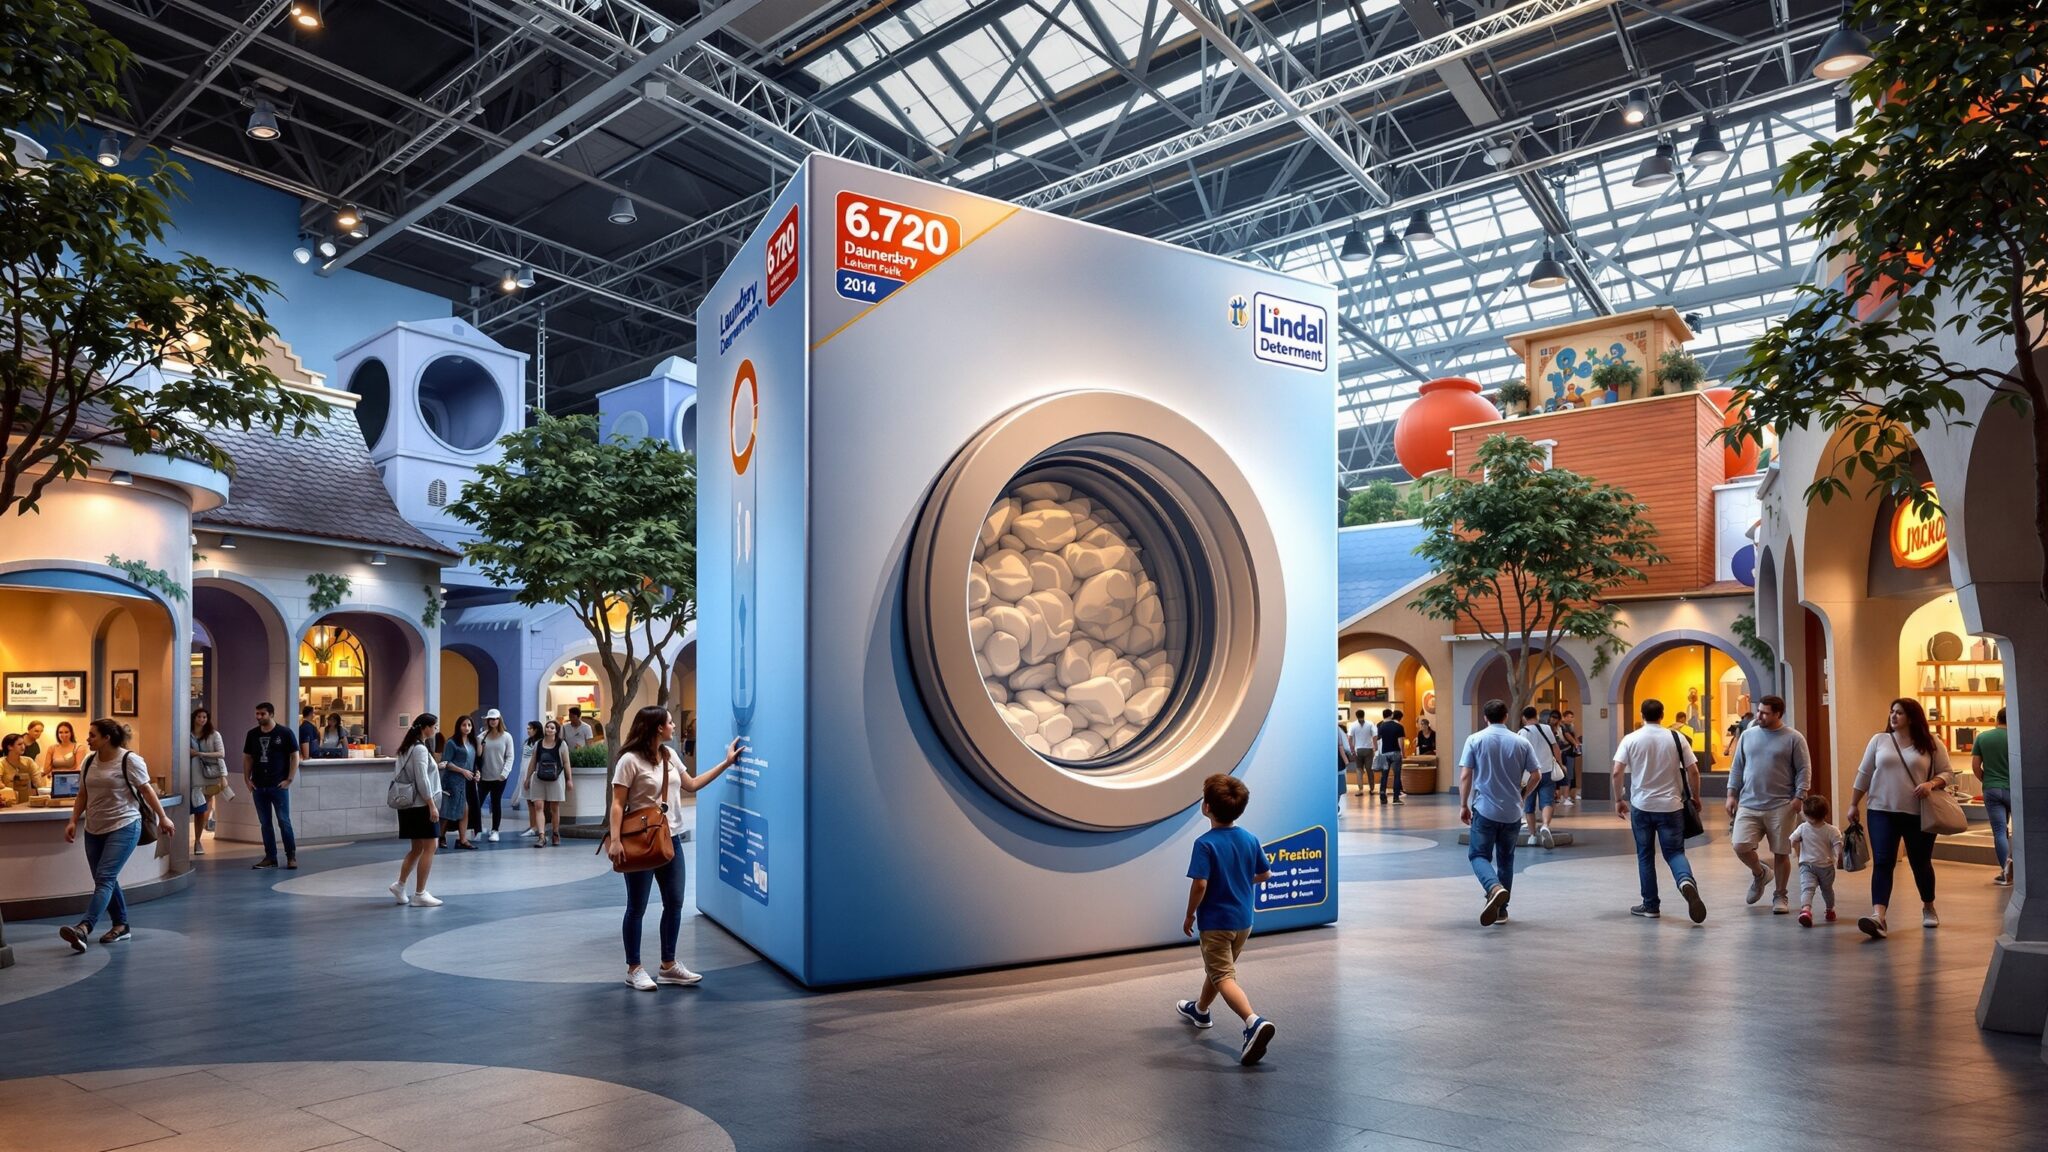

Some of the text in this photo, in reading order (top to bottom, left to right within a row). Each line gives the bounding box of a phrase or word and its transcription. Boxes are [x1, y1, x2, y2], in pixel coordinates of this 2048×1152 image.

[845, 202, 949, 256] 6.720
[844, 277, 877, 295] 2014
[1260, 304, 1323, 344] Lindal
[1260, 337, 1323, 362] Determent
